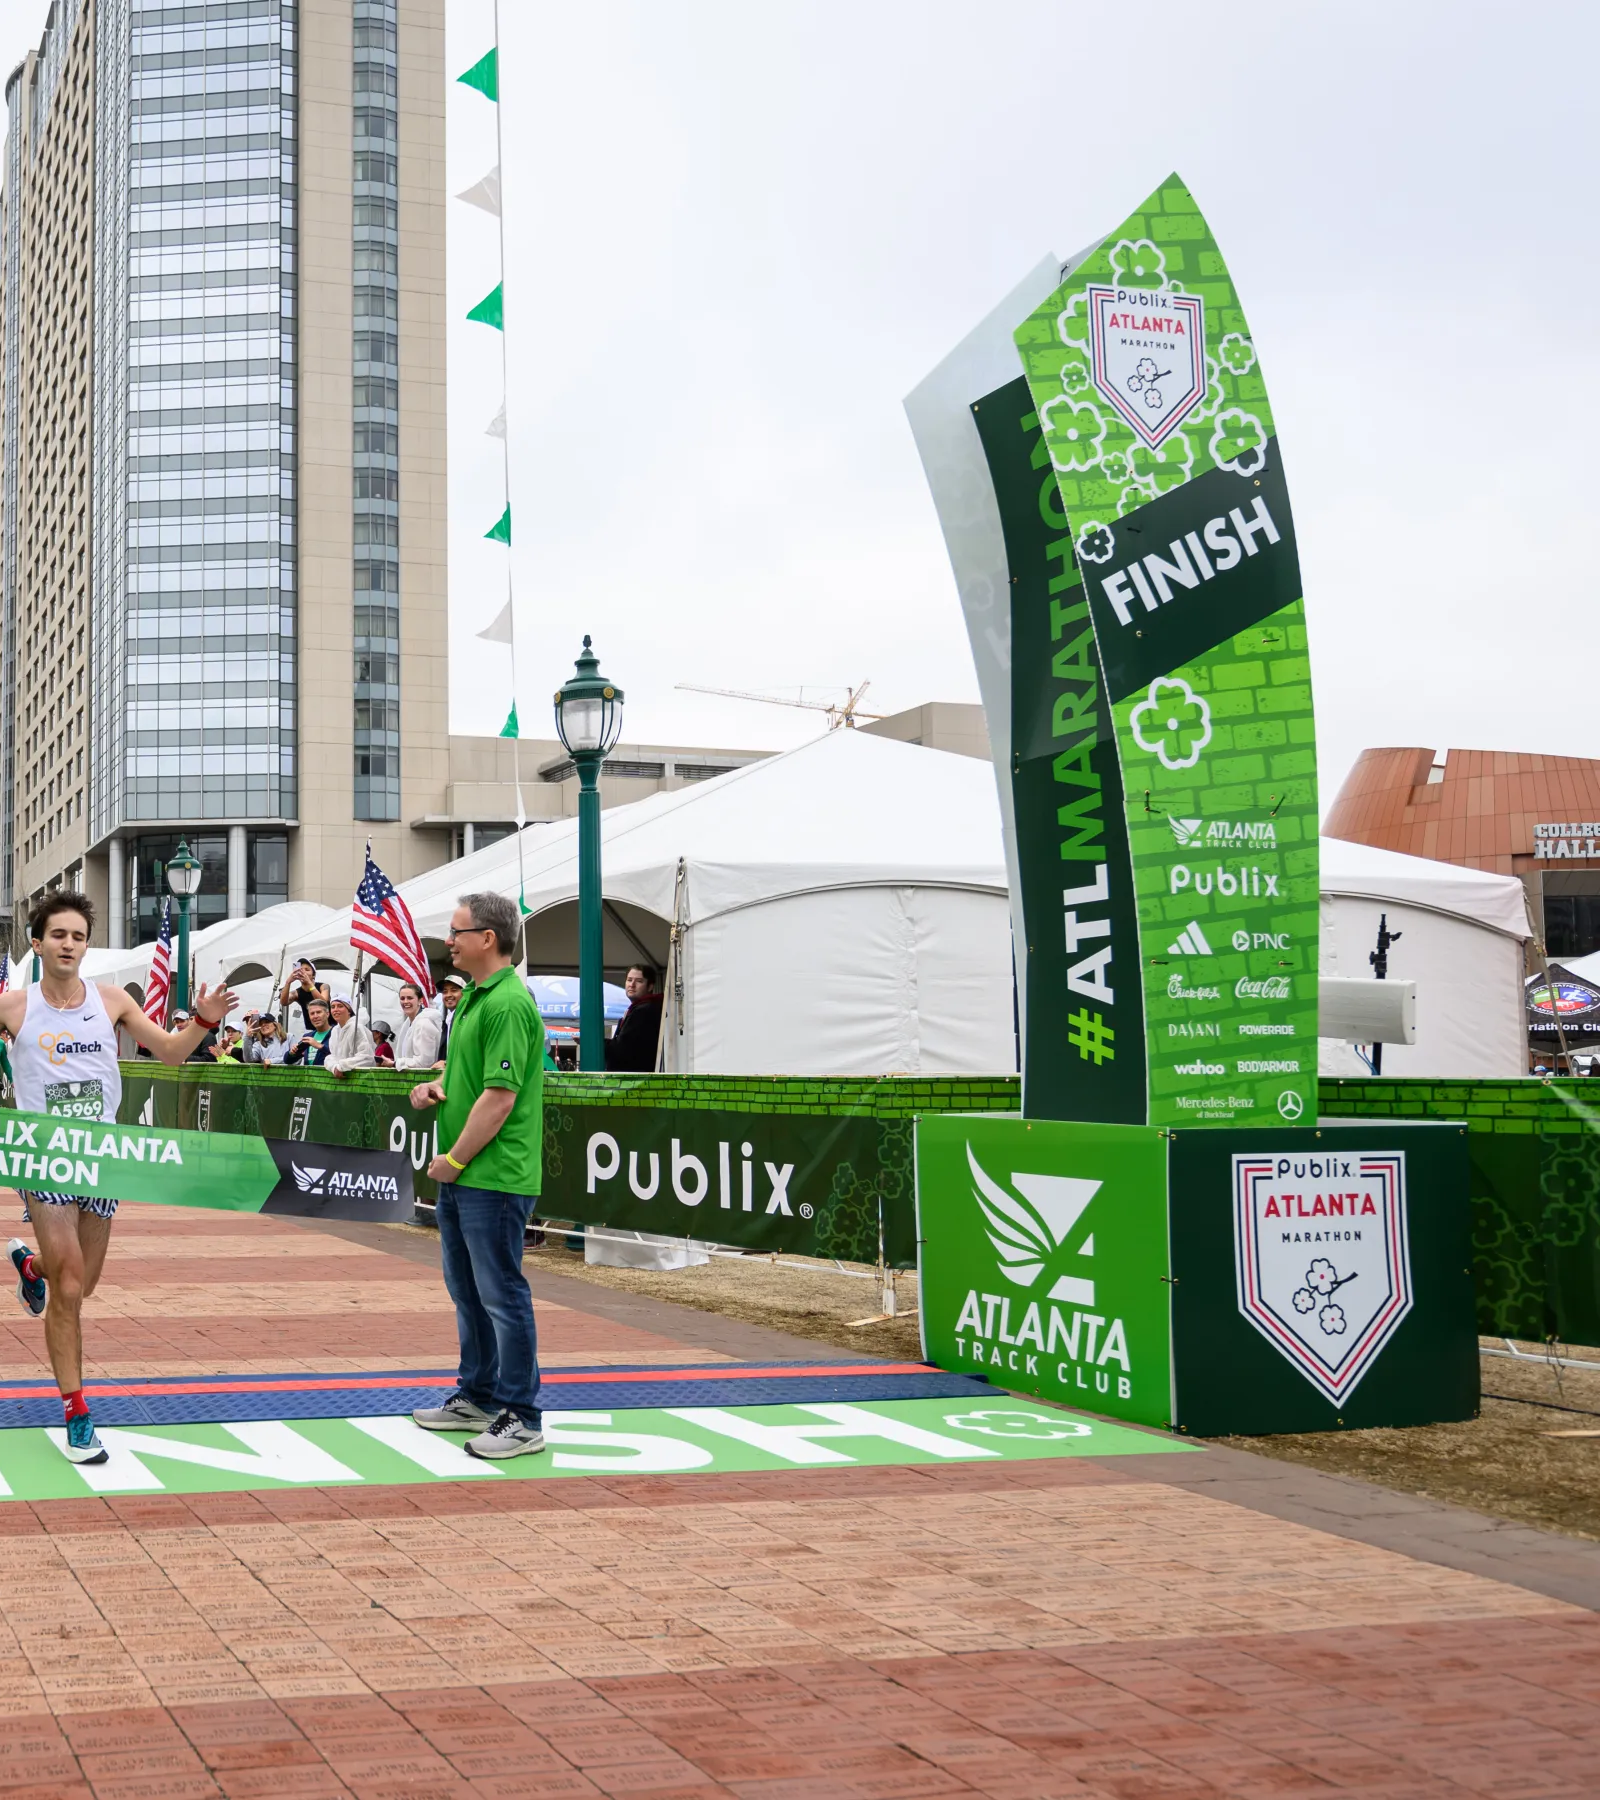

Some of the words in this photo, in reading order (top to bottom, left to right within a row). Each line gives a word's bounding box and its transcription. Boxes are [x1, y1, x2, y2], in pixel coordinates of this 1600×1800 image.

[1118, 289, 1168, 309] Publix
[1109, 313, 1186, 335] ATLANTA
[1121, 338, 1175, 351] MARATHON
[1101, 495, 1281, 627] FINISH
[1206, 821, 1276, 840] ATLANTA
[1206, 839, 1242, 848] TRACK
[1249, 840, 1277, 849] CLUB
[1533, 840, 1600, 859] HALL
[1170, 864, 1280, 897] Publix
[1252, 933, 1290, 950] PNC
[1234, 976, 1291, 999] Coca-Cola
[1169, 1021, 1220, 1039] DASANI
[1238, 1024, 1295, 1036] POWERADE
[56, 1041, 102, 1053] GaTech
[1174, 1059, 1225, 1075] wahoo
[1237, 1060, 1300, 1073] BODYARMOR
[50, 1101, 103, 1118] A5969
[1176, 1096, 1254, 1109] Mercedes-Benz
[48, 1126, 183, 1166] ATLANTA
[586, 1131, 795, 1217] Publix
[1277, 1157, 1352, 1180] Publix
[328, 1171, 399, 1194] ATLANTA
[328, 1187, 364, 1198] TRACK
[370, 1190, 399, 1201] CLUB
[1264, 1192, 1377, 1218] ATLANTA
[1281, 1229, 1363, 1243] MARATHON
[954, 1289, 1131, 1373] ATLANTA
[955, 1336, 1039, 1376] TRACK
[1057, 1362, 1131, 1399] CLUB
